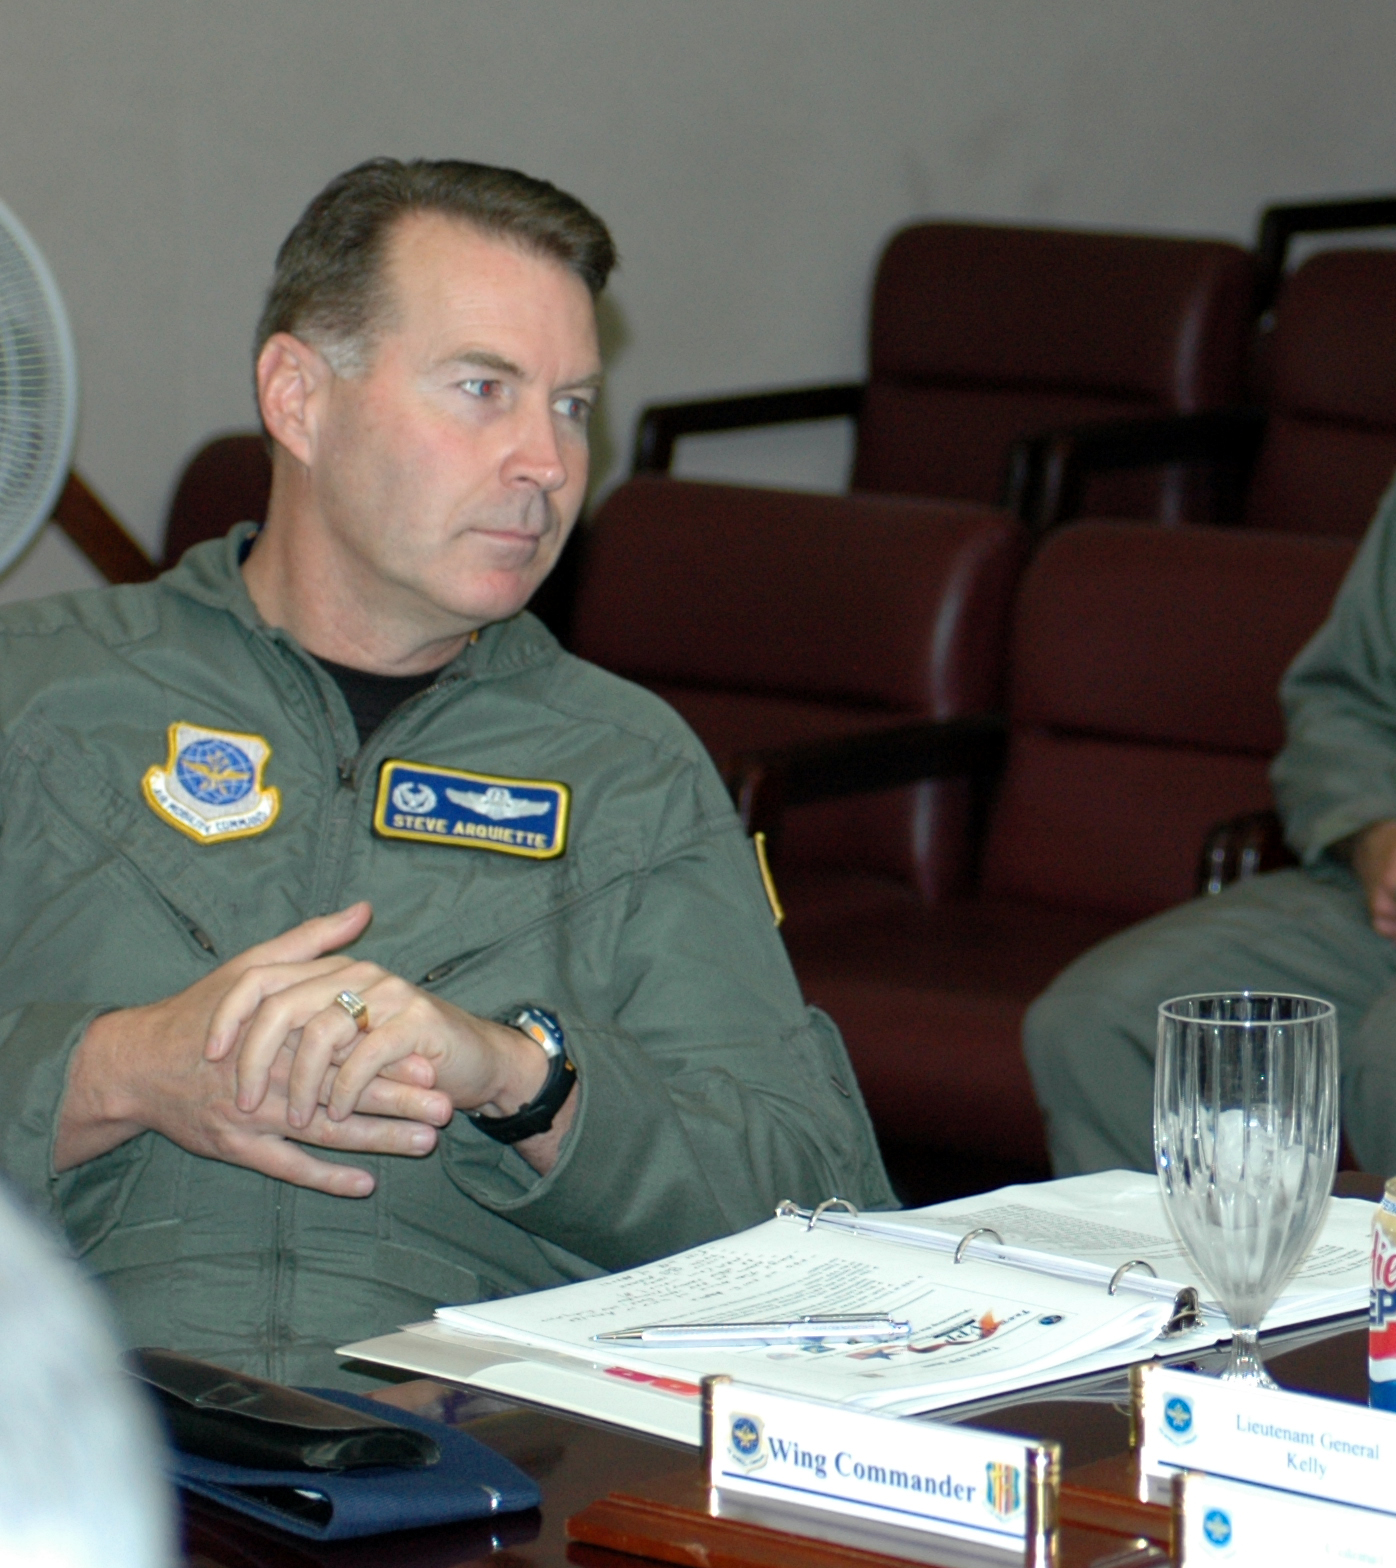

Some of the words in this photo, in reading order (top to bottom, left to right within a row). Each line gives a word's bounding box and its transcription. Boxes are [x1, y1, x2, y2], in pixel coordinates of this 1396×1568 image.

[393, 814, 448, 833] STEVE
[452, 821, 547, 849] ARQUIETTE
[1236, 1413, 1315, 1447] Lieutenant
[1320, 1432, 1380, 1461] General
[768, 1436, 827, 1478] Wing
[834, 1451, 977, 1502] Commander
[1286, 1452, 1328, 1480] Kelly
